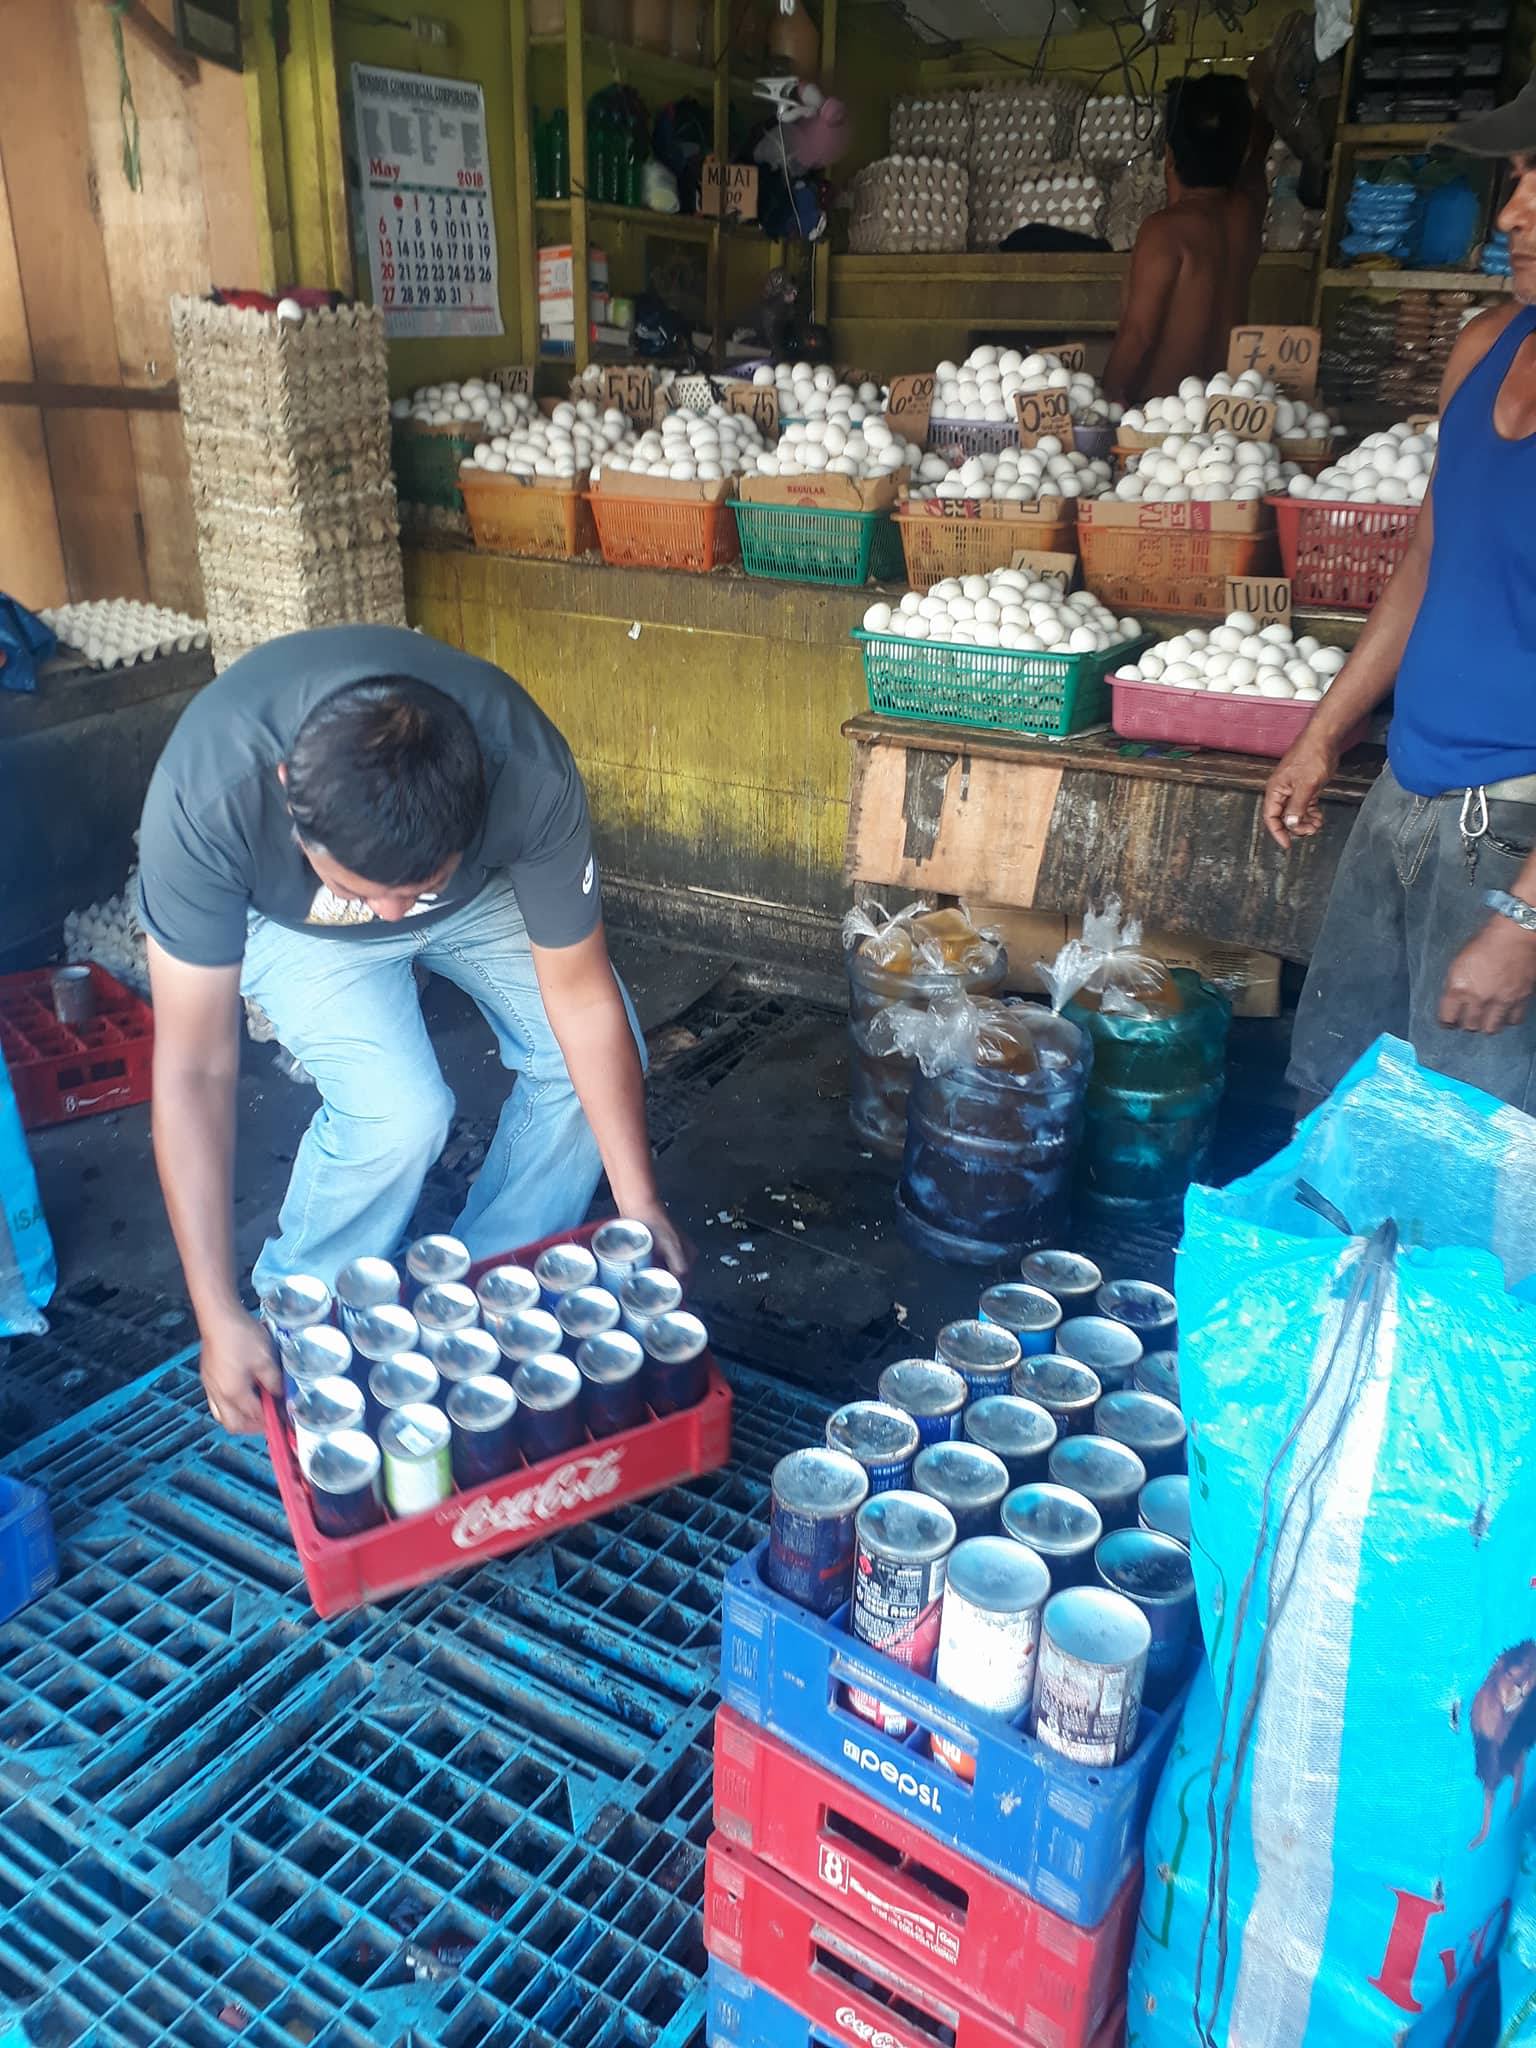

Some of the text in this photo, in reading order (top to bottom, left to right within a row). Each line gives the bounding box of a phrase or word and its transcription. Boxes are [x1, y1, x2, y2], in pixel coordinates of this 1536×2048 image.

[369, 159, 484, 186] May 2018
[428, 195, 436, 215] 2
[445, 196, 452, 216] 3
[461, 199, 468, 217] 4
[478, 201, 484, 218] 5
[378, 215, 490, 241] 6 7 8 9 10 11 12
[379, 240, 491, 262] 13 14 15 16 17 18 19
[381, 262, 492, 283] 20 21 22 23 24 25 26
[383, 286, 462, 304] 27 28 29 30 31
[888, 377, 934, 416] 6.00
[1019, 392, 1070, 433] 5.50
[786, 485, 826, 496] REGULAR
[1227, 581, 1288, 613] TULO
